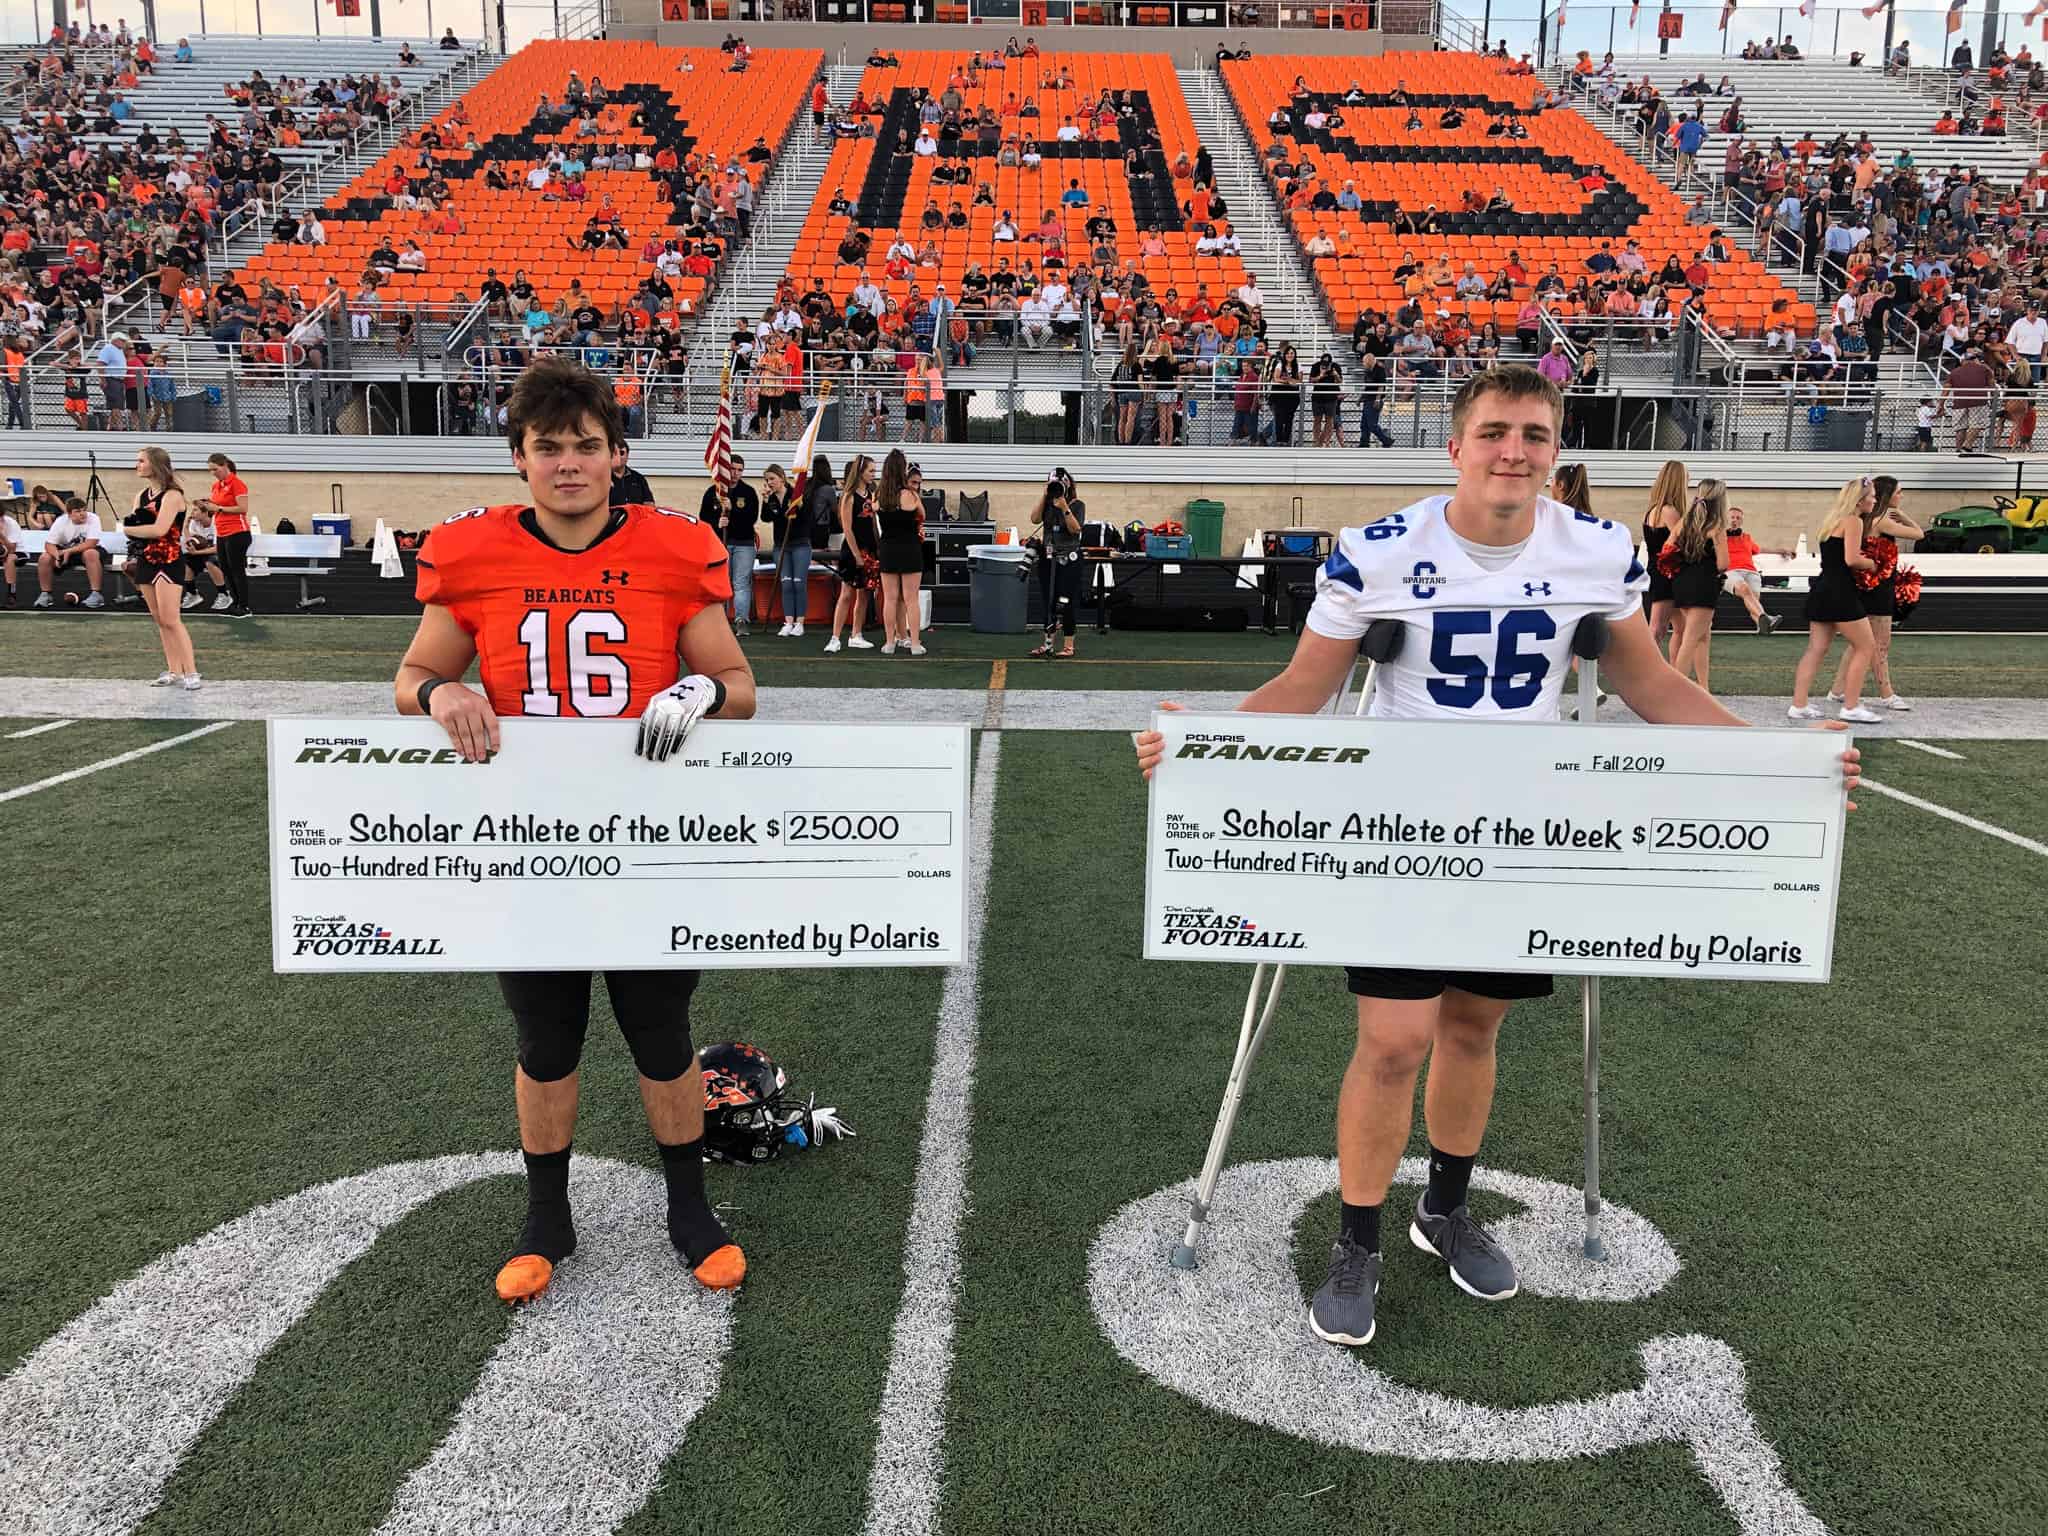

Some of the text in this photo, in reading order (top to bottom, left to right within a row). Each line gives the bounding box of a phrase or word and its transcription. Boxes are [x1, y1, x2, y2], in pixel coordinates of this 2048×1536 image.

[1028, 9, 1041, 25] R
[1350, 12, 1362, 29] C
[1402, 576, 1447, 585] SPARTANS
[524, 588, 615, 604] BEARCATS
[518, 608, 631, 718] 16
[1426, 609, 1557, 710] 56
[304, 738, 368, 746] POLARIS
[1185, 734, 1246, 743] POLARIS
[685, 752, 793, 767] DATE Fall 2019
[1176, 743, 1371, 764] RANGER
[1555, 755, 1665, 772] DATE Fall 2019
[289, 821, 308, 829] PAY
[1166, 814, 1184, 822] PAY
[289, 829, 325, 837] TO THE
[349, 813, 900, 844] Scholar Athlete of the Week $ 250.00
[1166, 822, 1200, 831] TO THE
[1222, 808, 1769, 850] Scholar Athlete of the Week $ 250.00
[289, 838, 343, 846] ORDER OF
[1166, 831, 1216, 840] ORDER OF
[289, 854, 621, 882] Two-Hundred Fifty and 00/100
[1164, 848, 1484, 879] Two-Hundred Fifty and 00/100
[907, 870, 952, 878] DOLLARS
[1774, 882, 1820, 892] DOLLARS
[1163, 913, 1240, 929] TEXAS
[292, 923, 375, 938] TEXAS
[670, 923, 940, 956] Presented by Polaris
[1162, 929, 1308, 949] FOOTBALL
[292, 939, 447, 956] FOOTBALL
[1527, 929, 1802, 967] Presented by Polaris
